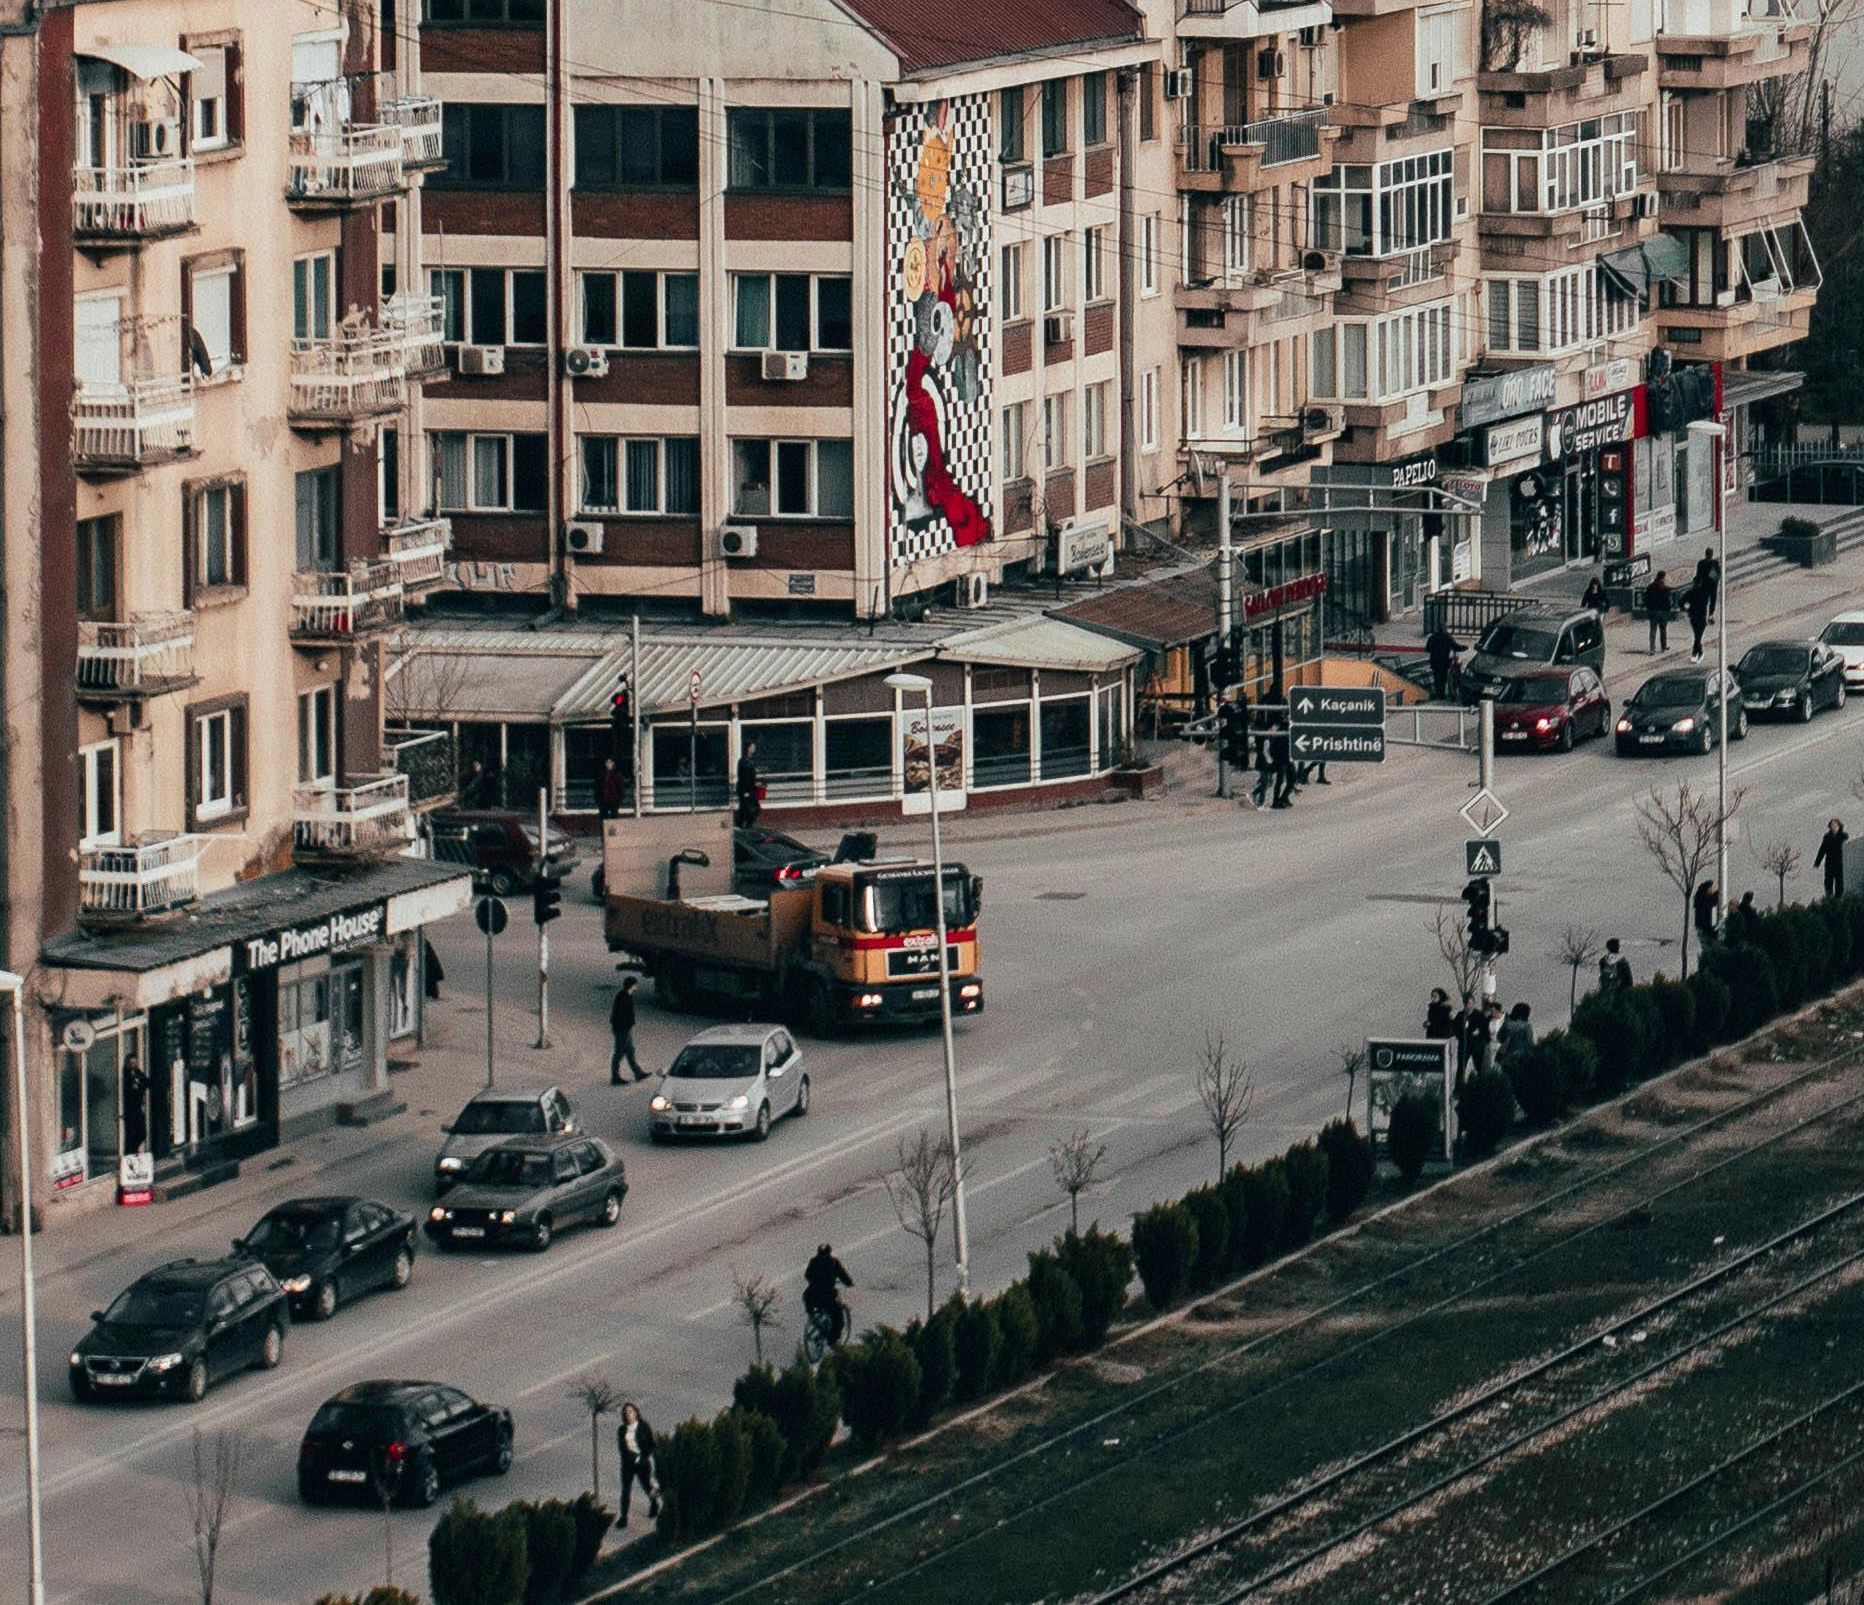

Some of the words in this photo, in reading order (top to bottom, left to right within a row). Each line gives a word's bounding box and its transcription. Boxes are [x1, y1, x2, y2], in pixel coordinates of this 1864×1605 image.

[1576, 394, 1626, 431] MOBILE
[1575, 425, 1619, 452] SERVICE
[1392, 459, 1436, 487] PAPELIO
[1321, 698, 1376, 714] Kaçanik
[1312, 736, 1382, 752] Prishtinë
[248, 937, 278, 969] The
[280, 924, 330, 960] Phone
[330, 909, 379, 944] House
